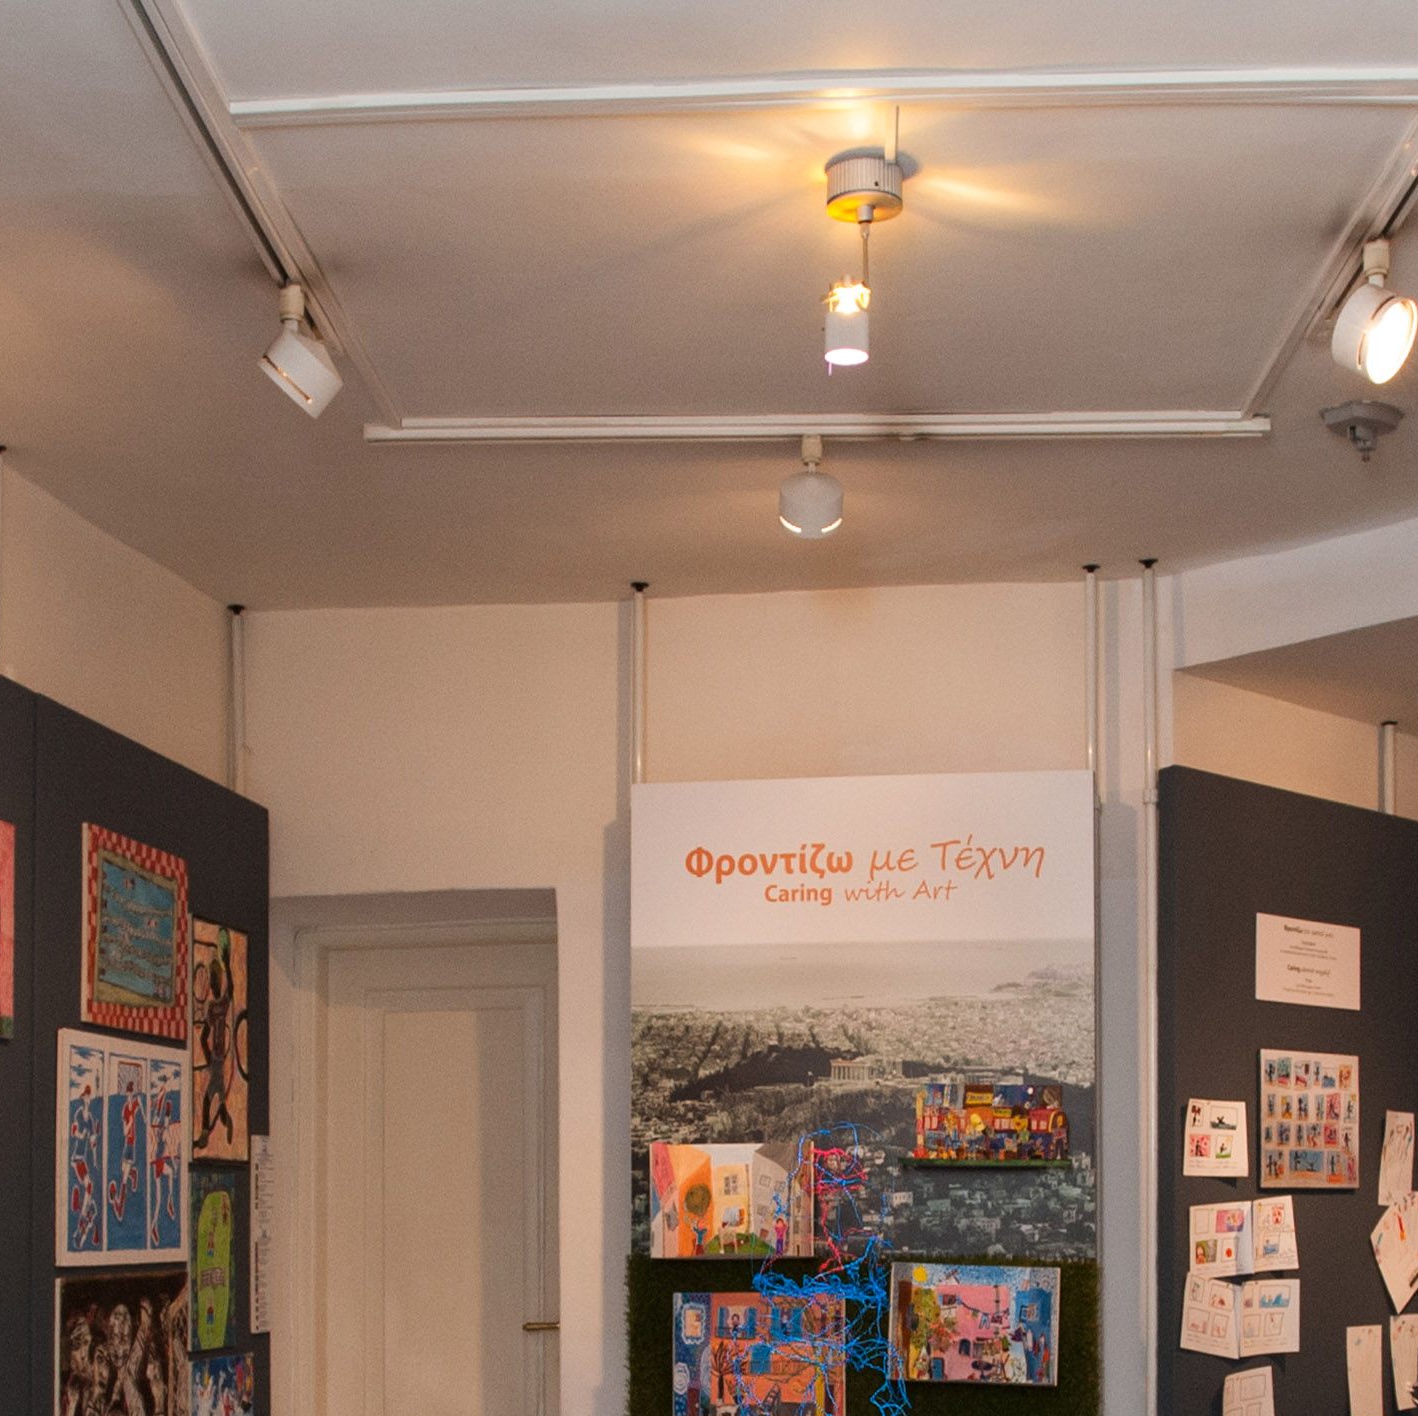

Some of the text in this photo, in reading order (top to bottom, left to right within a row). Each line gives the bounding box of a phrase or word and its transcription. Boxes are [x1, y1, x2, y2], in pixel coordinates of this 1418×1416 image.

[684, 833, 1046, 886] Φροντίζω με Τέχνη
[764, 878, 959, 908] Caring with Art
